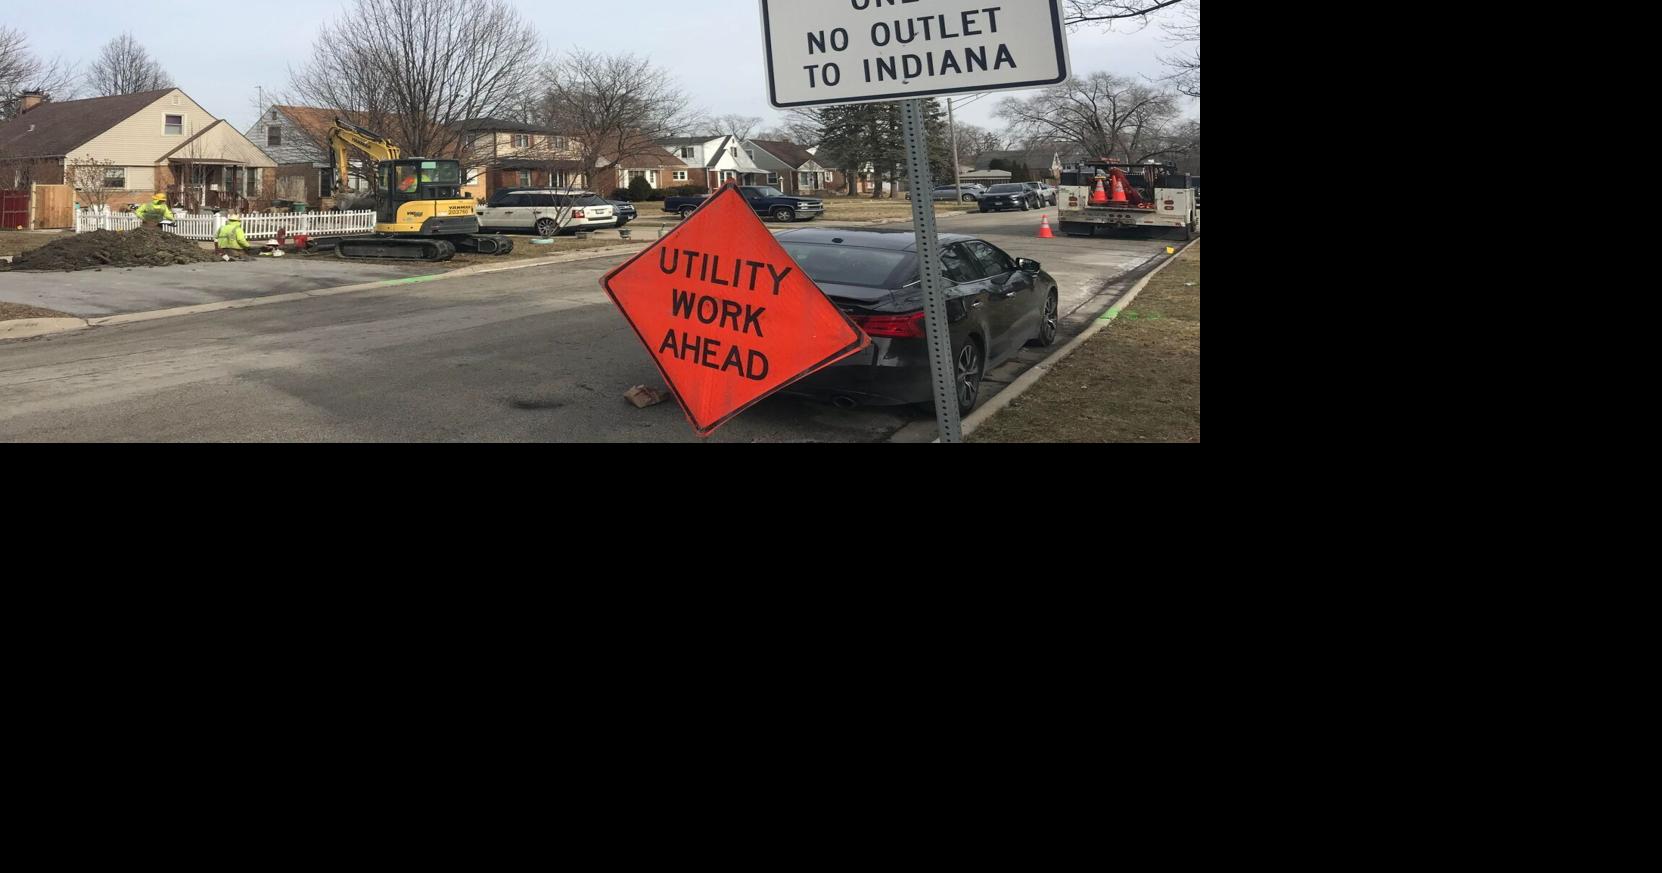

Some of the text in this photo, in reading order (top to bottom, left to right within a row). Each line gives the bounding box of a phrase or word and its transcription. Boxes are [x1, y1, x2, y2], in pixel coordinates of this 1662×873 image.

[807, 7, 1001, 55] NO OUTLET
[803, 43, 1017, 88] TO INDIANA
[659, 246, 792, 296] UTILITY
[671, 288, 766, 338] WORK
[658, 328, 769, 381] AHEAD
